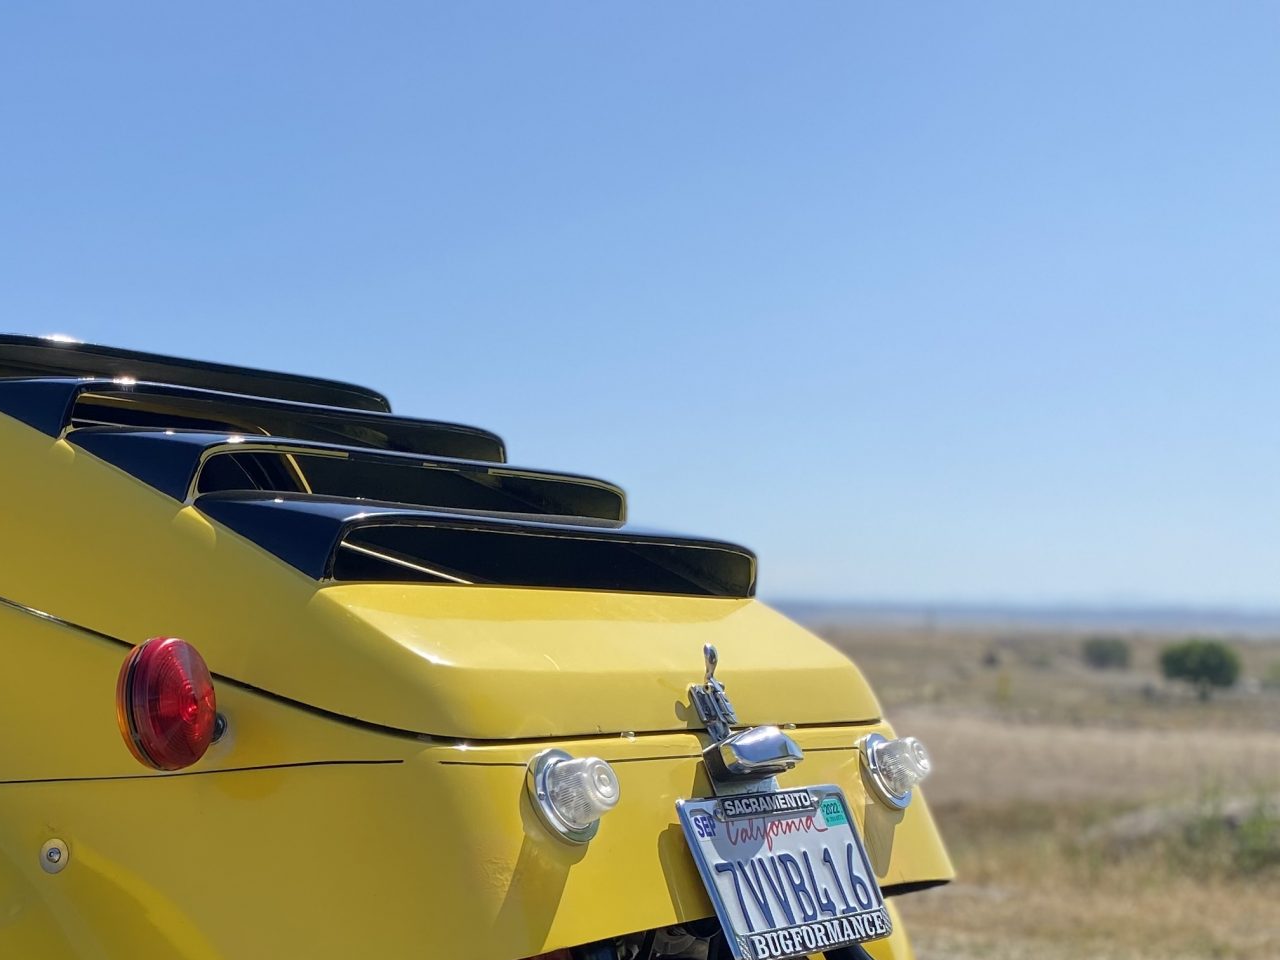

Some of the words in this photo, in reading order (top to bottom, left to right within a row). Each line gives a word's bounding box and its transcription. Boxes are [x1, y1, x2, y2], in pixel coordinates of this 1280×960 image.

[724, 793, 811, 815] SACRAMENTO
[694, 815, 716, 838] SEP
[725, 815, 828, 851] California
[715, 843, 872, 932] 7VVB416
[750, 915, 885, 959] BUGFORMANCE
